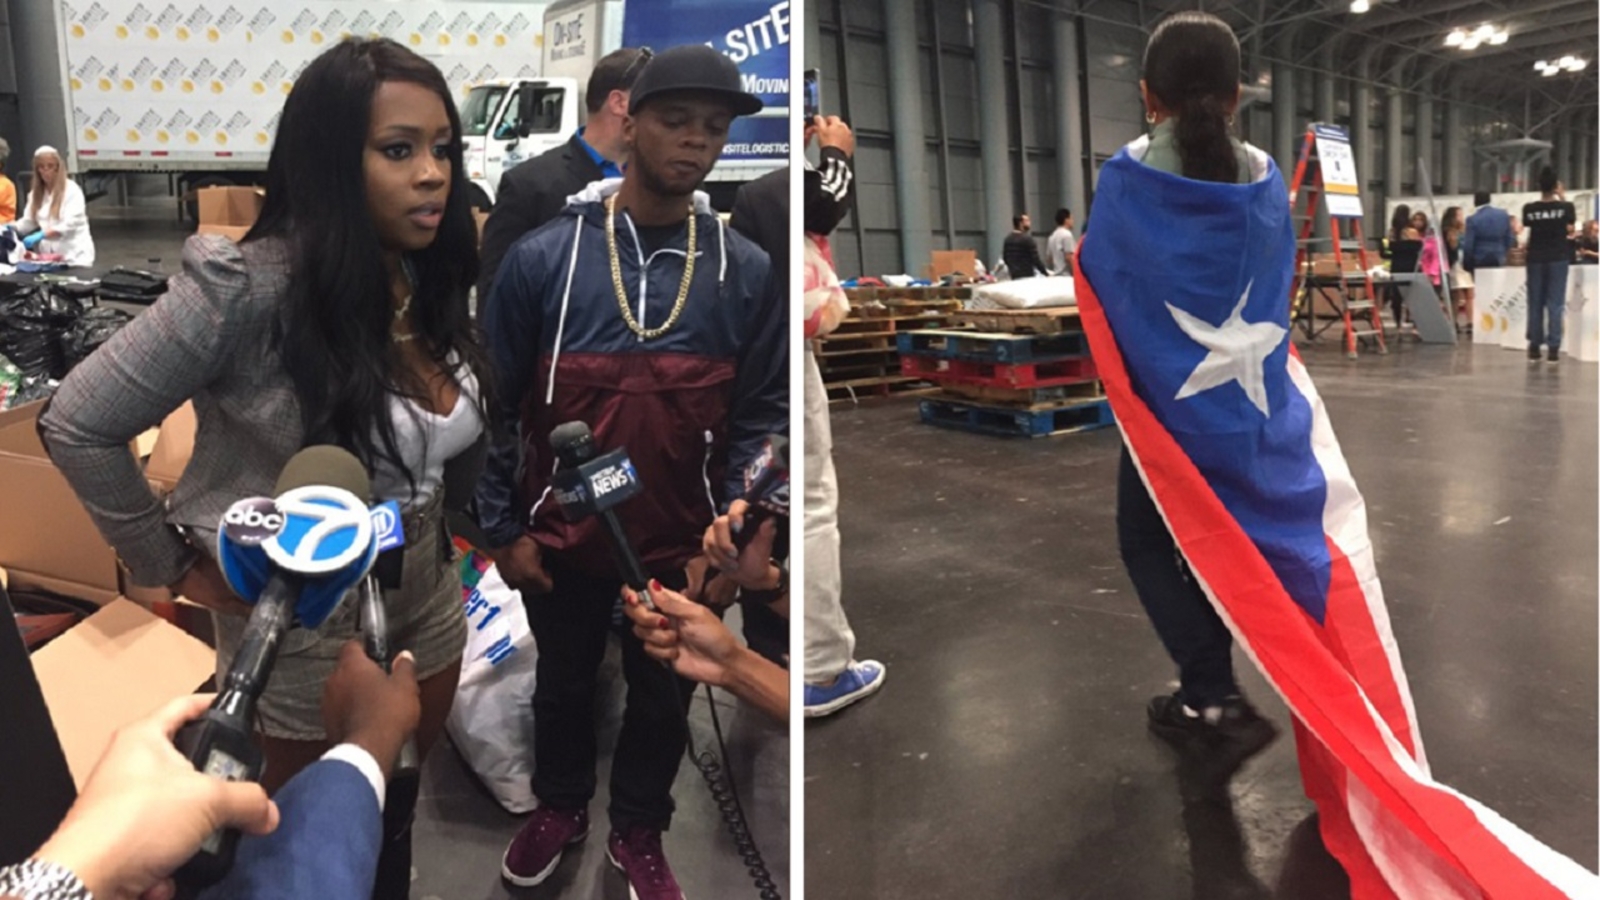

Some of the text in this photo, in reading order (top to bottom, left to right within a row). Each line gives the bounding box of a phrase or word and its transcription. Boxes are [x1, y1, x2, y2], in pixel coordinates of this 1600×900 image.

[1526, 209, 1565, 221] STAFF
[591, 468, 628, 498] NEWS
[225, 494, 366, 568] abc 7
